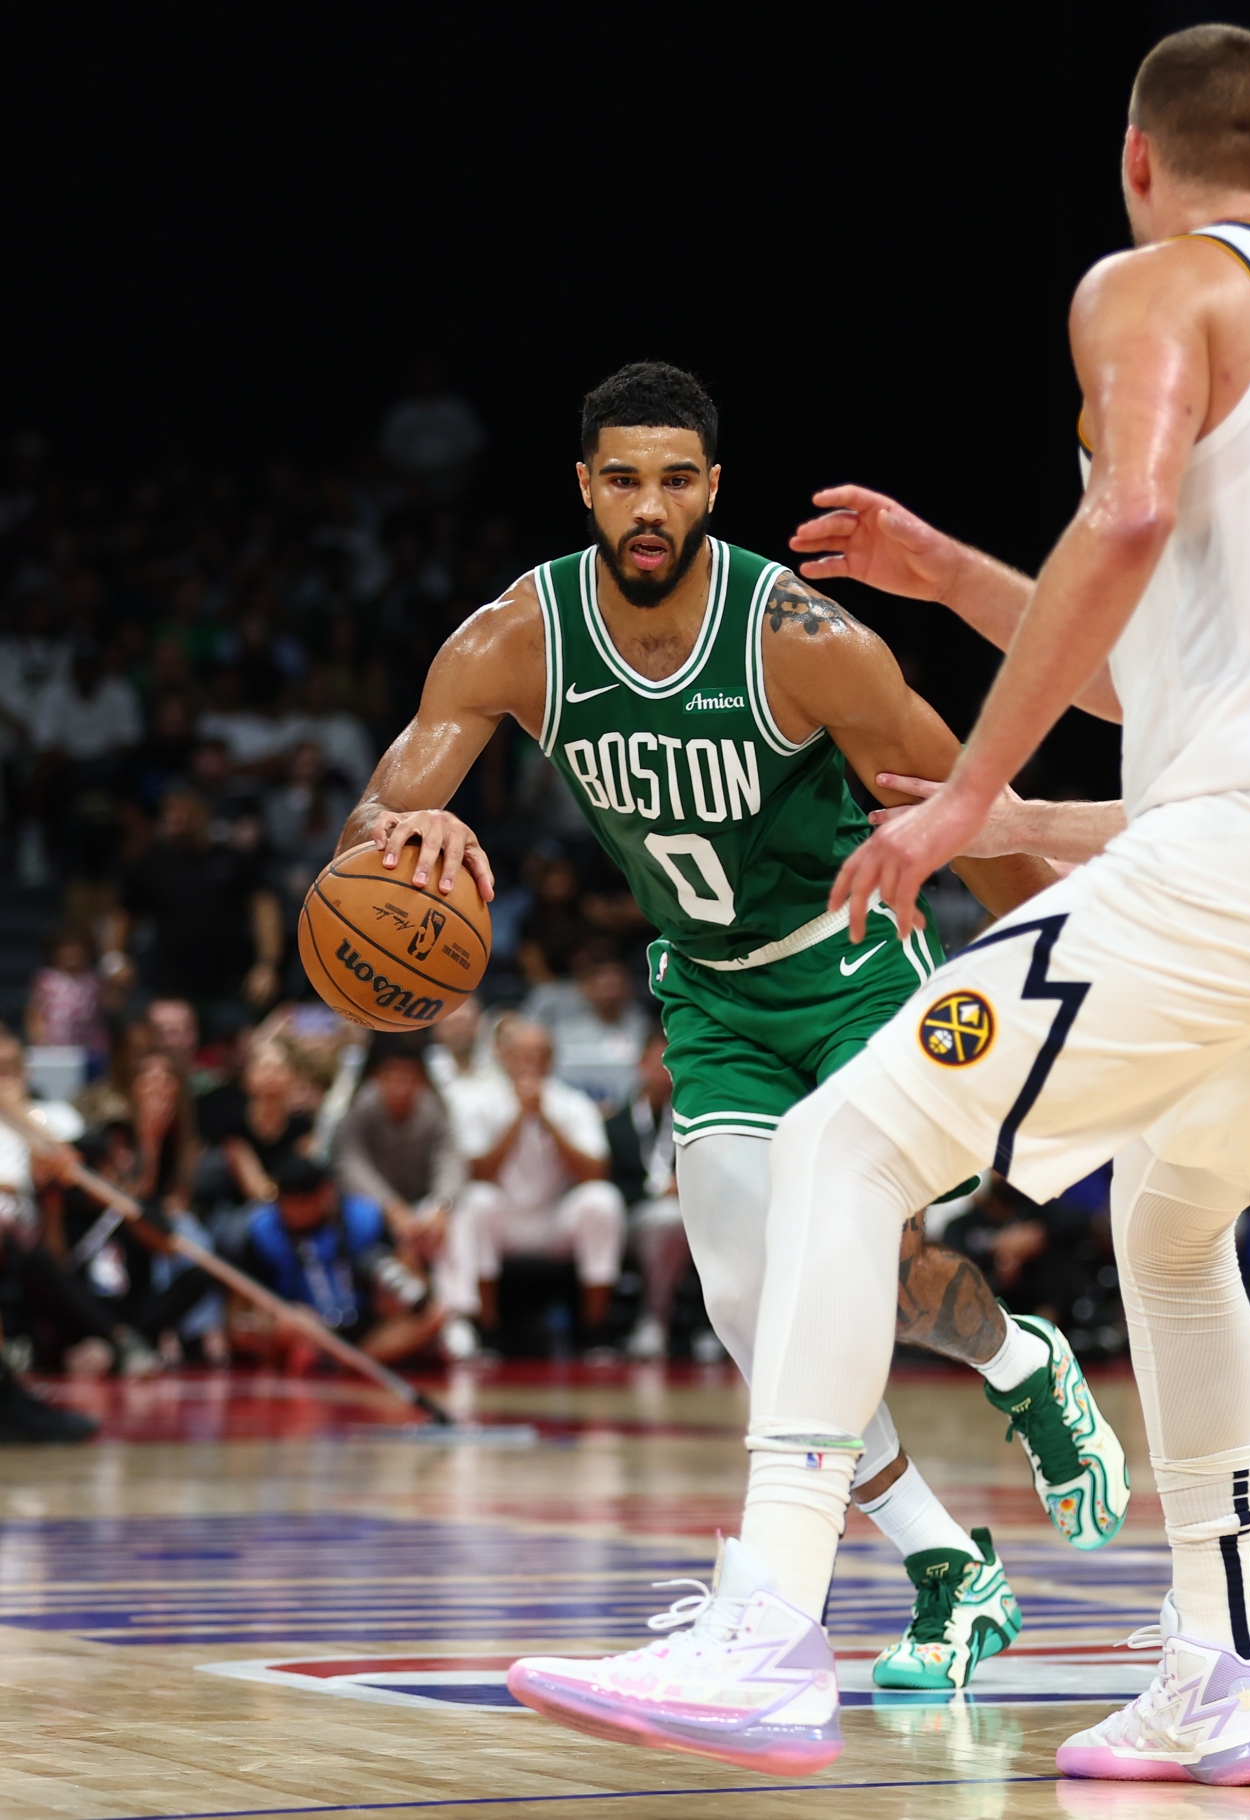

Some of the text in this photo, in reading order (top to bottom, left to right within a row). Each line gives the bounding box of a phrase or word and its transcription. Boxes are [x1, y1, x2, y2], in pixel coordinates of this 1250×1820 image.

[685, 692, 745, 711] Amica
[563, 731, 761, 823] BOSTON
[643, 832, 737, 926] 0
[334, 937, 445, 1020] Wilson
